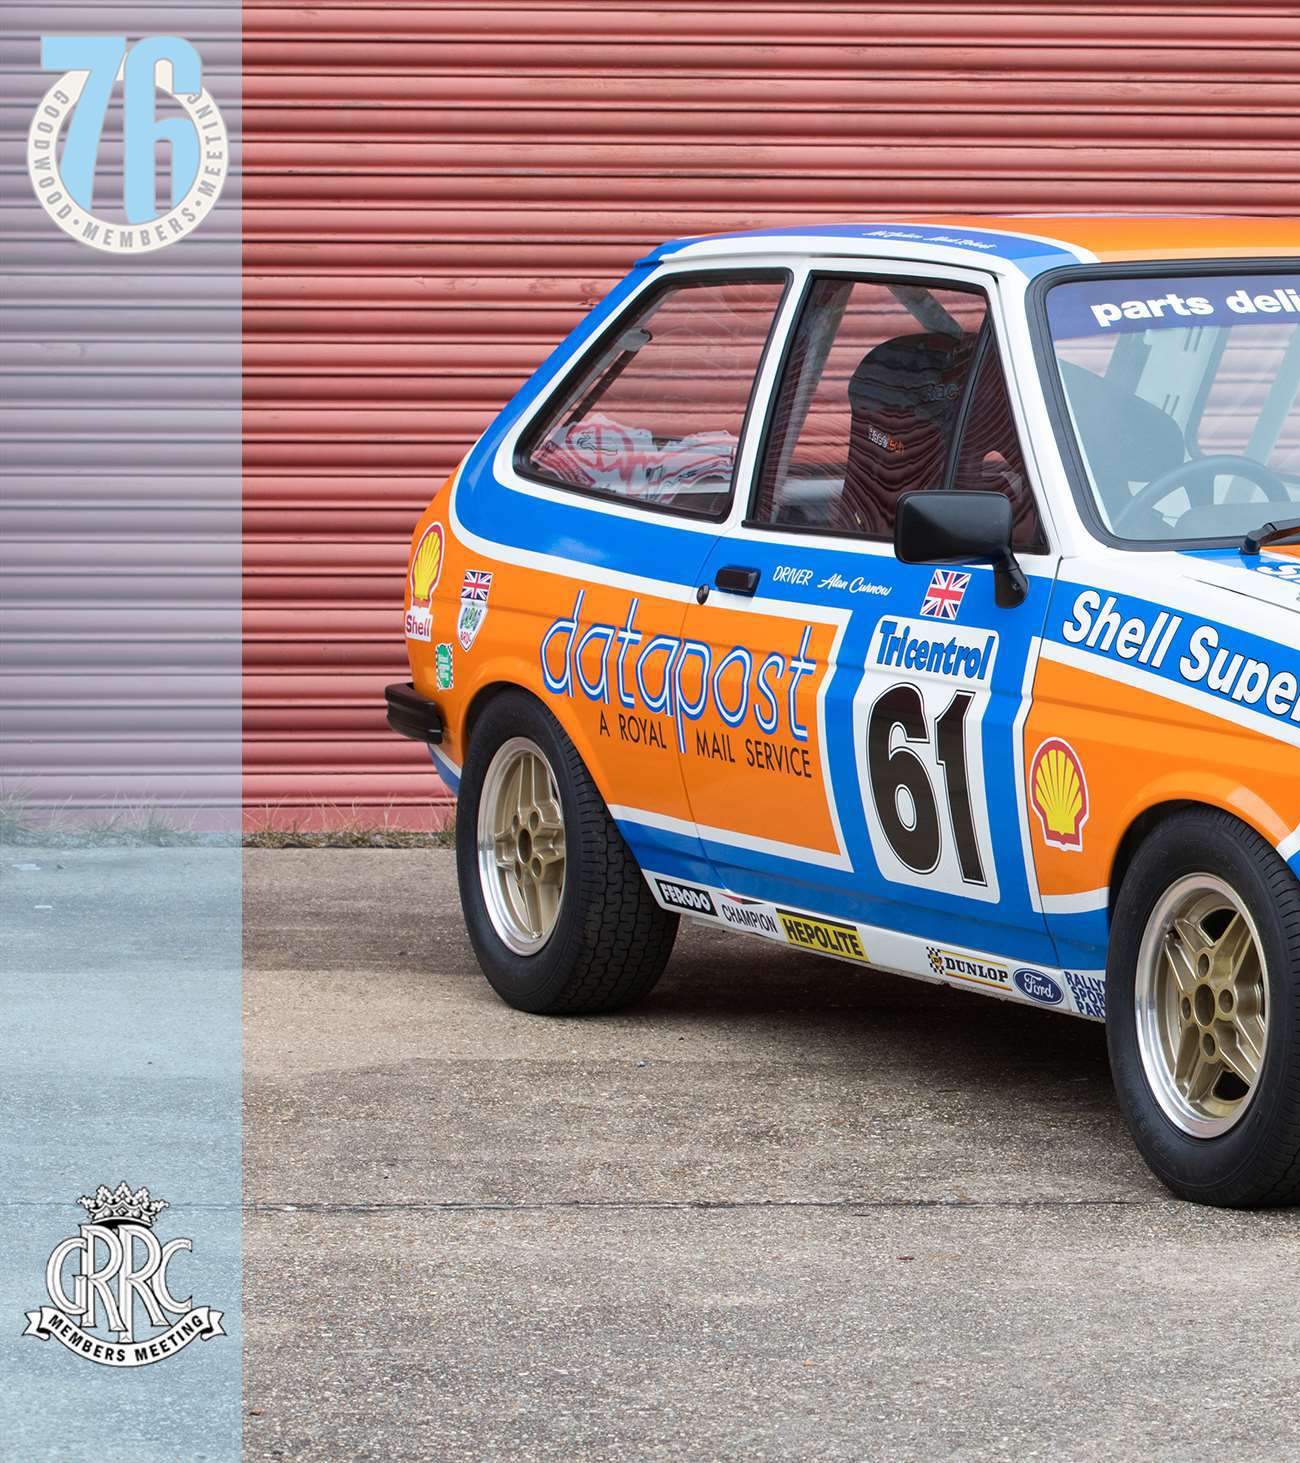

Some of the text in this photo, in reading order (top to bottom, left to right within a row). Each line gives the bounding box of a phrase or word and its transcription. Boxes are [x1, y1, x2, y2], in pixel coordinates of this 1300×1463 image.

[1089, 293, 1214, 328] parts
[773, 565, 814, 586] DRIVER
[817, 573, 848, 590] Alan
[406, 614, 432, 637] Shell
[1062, 589, 1184, 669] Shell
[876, 619, 996, 680] Tricentrol
[540, 588, 816, 754] datapost
[600, 710, 813, 778] A ROYAL MAIL SERVICE
[866, 681, 988, 887] 61
[660, 882, 711, 912] FERODO
[721, 904, 778, 935] CHAMPION
[783, 918, 864, 957] HEPOLITE
[944, 956, 1008, 983] DUNLOP
[1064, 971, 1105, 993] RALLY
[1023, 972, 1054, 999] Ford
[1071, 986, 1105, 1007] SPOR
[1076, 1000, 1105, 1018] PAR
